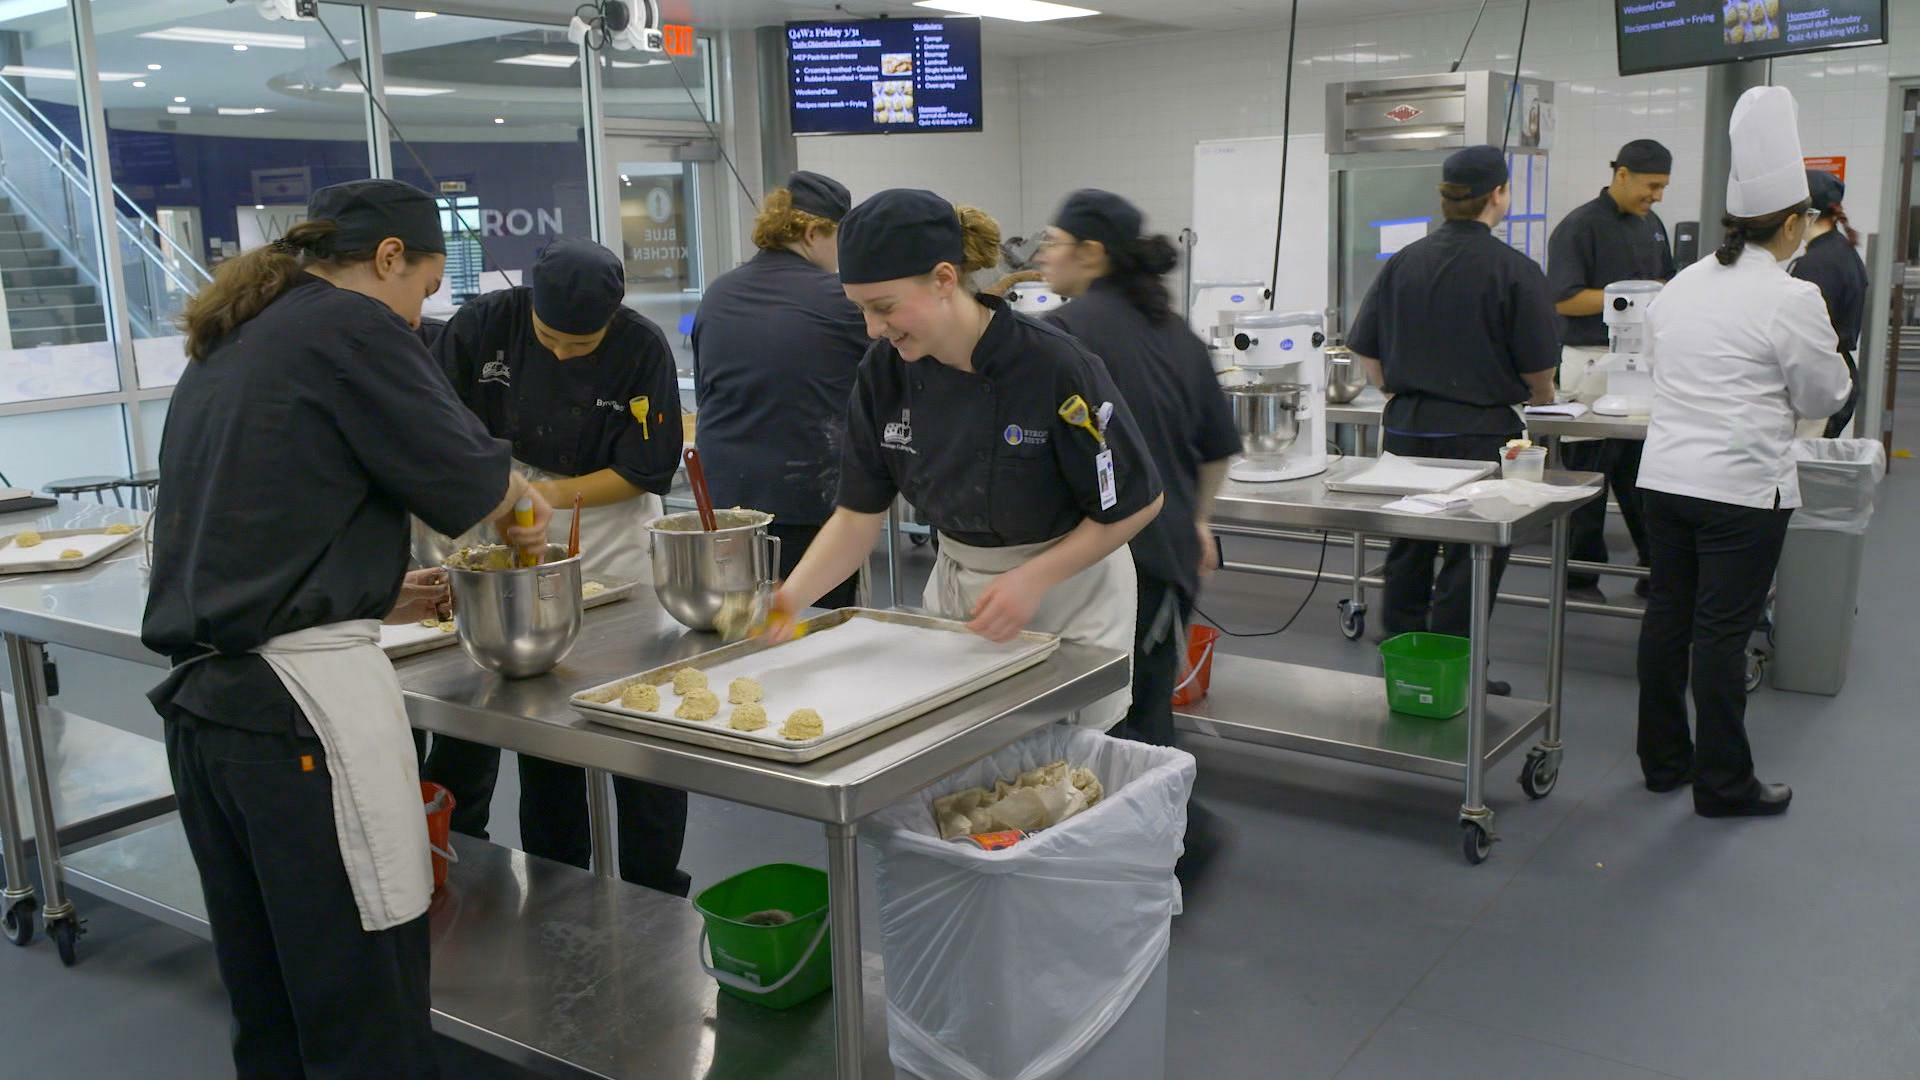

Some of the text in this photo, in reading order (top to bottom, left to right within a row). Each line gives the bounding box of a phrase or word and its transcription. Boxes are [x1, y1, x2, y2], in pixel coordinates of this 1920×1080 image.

[1624, 0, 1675, 14] Weekend Clean
[1666, 18, 1684, 27] week
[1692, 14, 1715, 24] Frying
[1788, 14, 1861, 32] Journal due Monday
[788, 27, 860, 39] Q4W2 Friday 3/31
[1787, 33, 1804, 42] Quiz
[1820, 29, 1845, 38] Baking
[663, 25, 693, 55] EXIT
[850, 100, 868, 109] Frying
